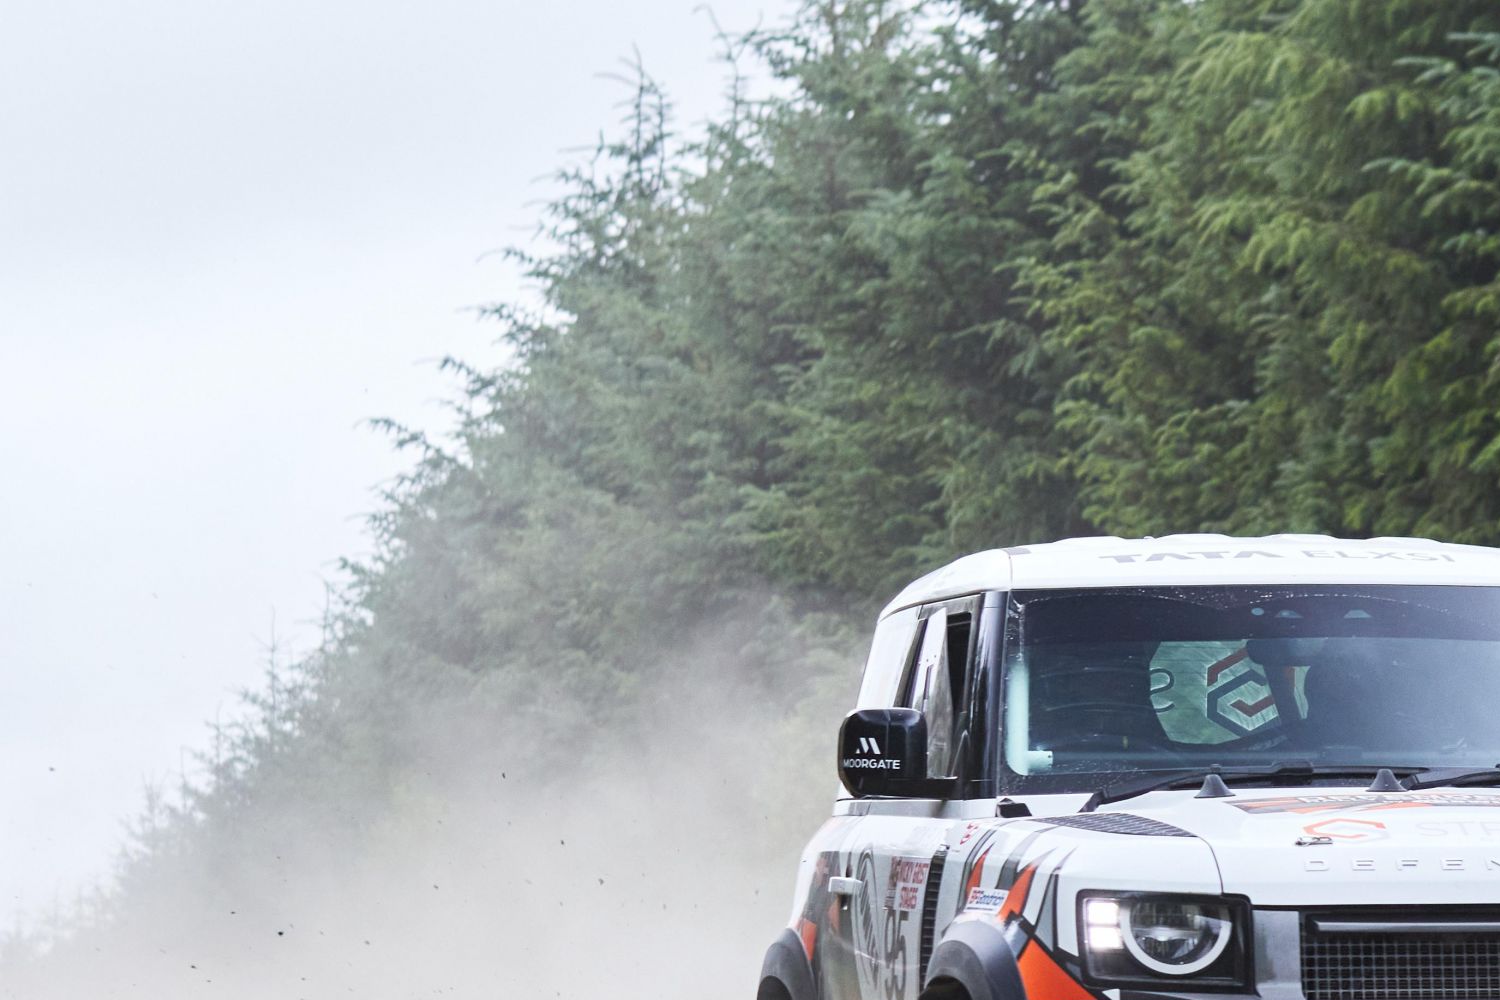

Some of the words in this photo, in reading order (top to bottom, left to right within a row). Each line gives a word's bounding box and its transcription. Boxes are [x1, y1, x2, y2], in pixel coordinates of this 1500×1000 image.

[1098, 550, 1285, 564] TATA
[1301, 550, 1456, 563] ELXSI
[843, 758, 901, 770] MOORGATE
